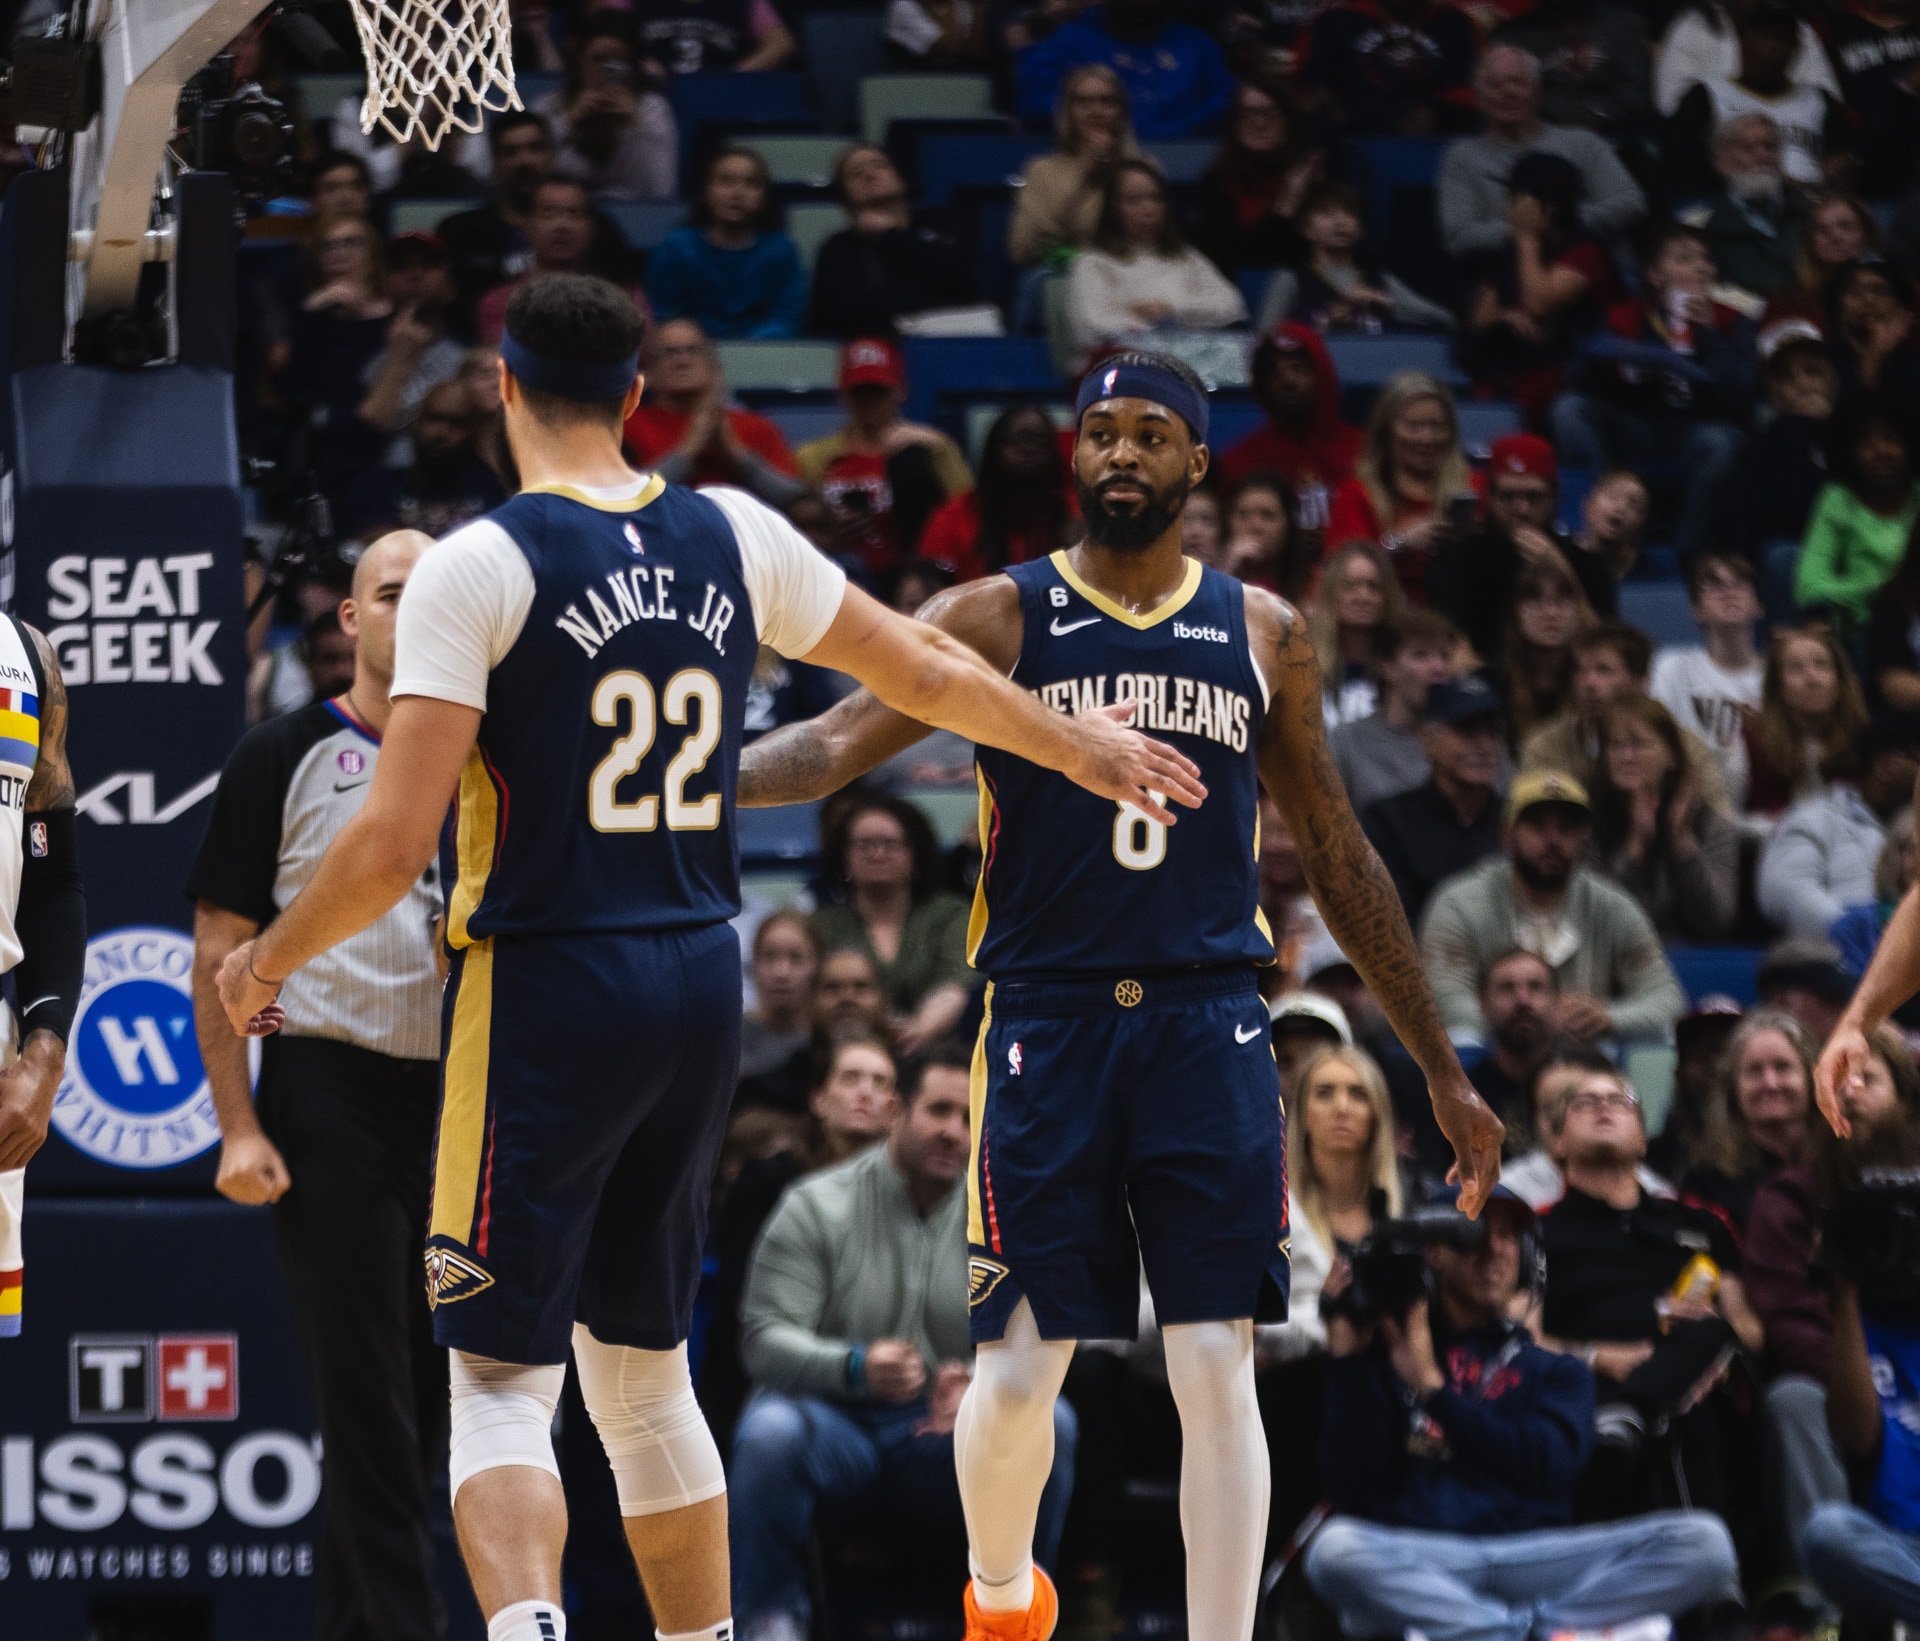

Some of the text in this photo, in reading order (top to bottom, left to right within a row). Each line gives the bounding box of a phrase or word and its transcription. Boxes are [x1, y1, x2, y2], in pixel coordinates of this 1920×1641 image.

[46, 552, 214, 621] SEAT
[556, 565, 735, 660] NANCE JR.
[1049, 586, 1069, 607] 6
[47, 619, 224, 687] GEEK
[1173, 622, 1229, 644] ibotta
[1114, 673, 1250, 754] ORLEANS
[588, 667, 723, 834] 22
[1112, 784, 1167, 871] 8
[81, 1350, 142, 1412] T
[0, 1430, 324, 1532] ISSO
[26, 1546, 191, 1580] WATCHES
[207, 1545, 315, 1578] SINCE
